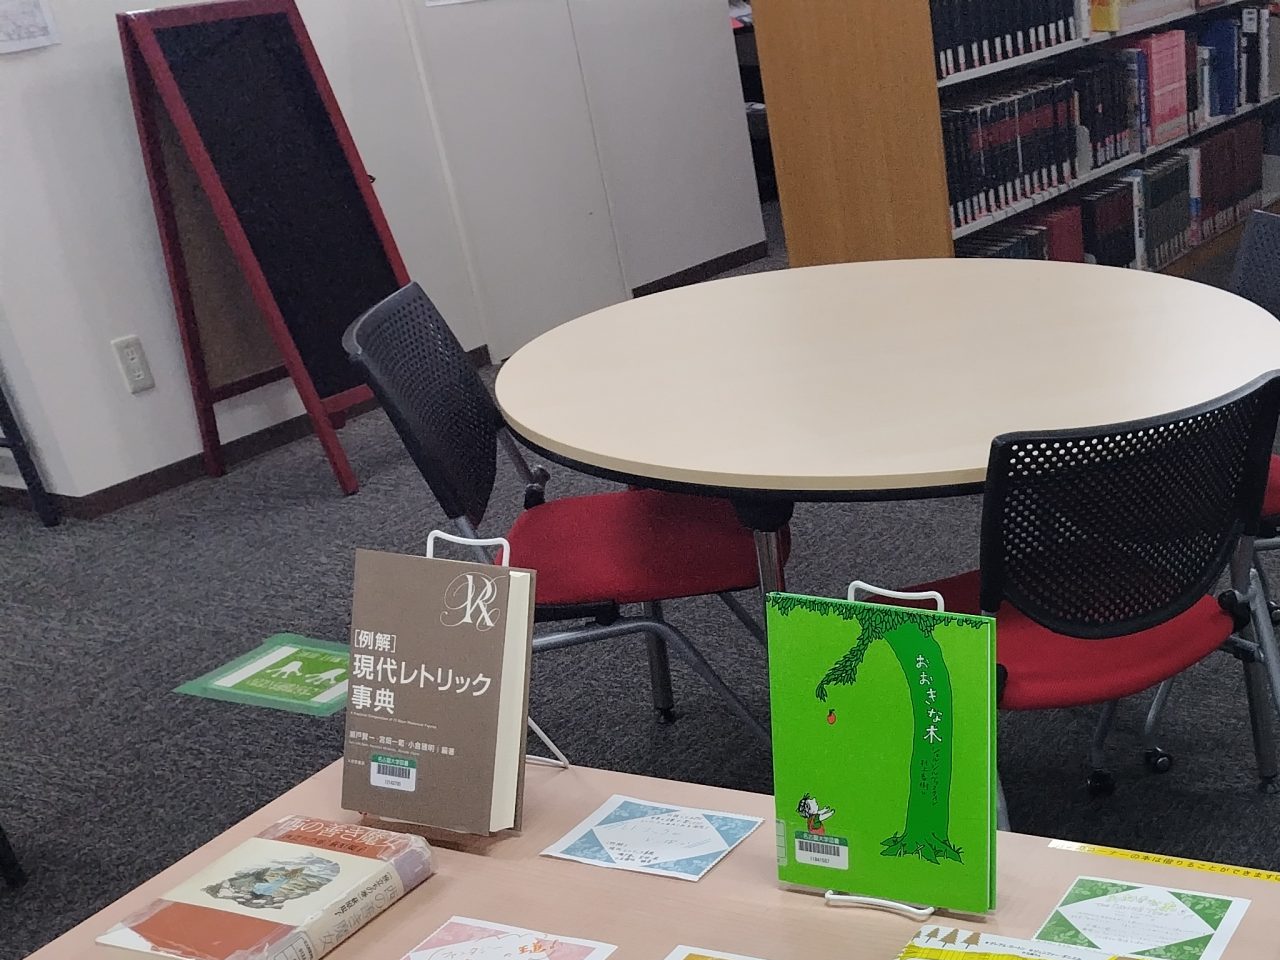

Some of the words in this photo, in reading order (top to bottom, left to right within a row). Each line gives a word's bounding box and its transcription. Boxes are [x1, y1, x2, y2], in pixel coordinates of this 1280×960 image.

[352, 653, 493, 698] 現代レトリック
[350, 683, 396, 715] 事典
[915, 653, 943, 744] おおきな木
